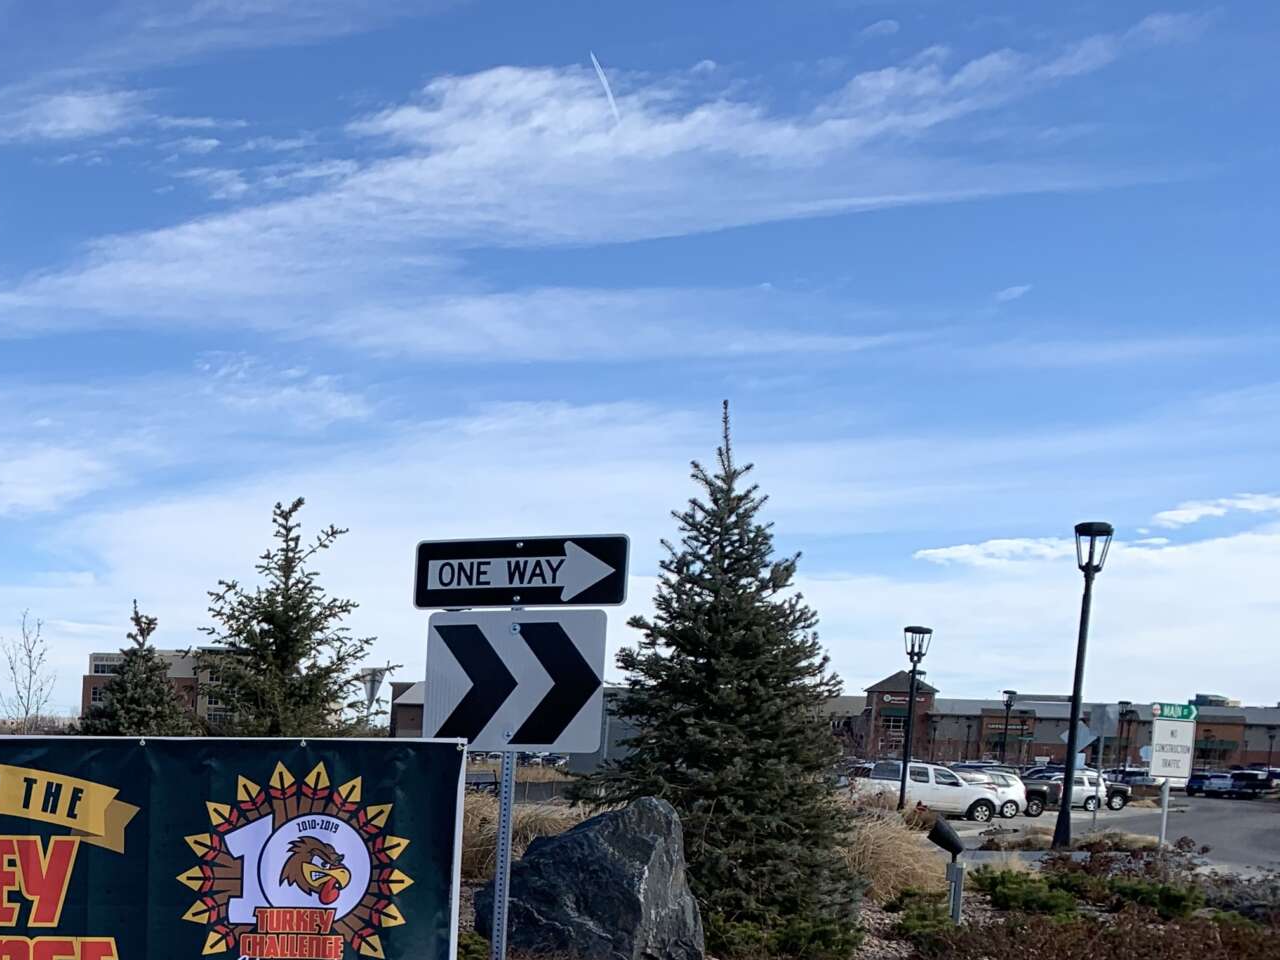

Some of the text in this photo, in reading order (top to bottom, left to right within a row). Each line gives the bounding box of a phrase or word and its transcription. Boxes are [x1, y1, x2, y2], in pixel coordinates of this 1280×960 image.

[438, 559, 566, 587] ONE WAY
[1163, 704, 1183, 717] MAIN
[1155, 743, 1191, 754] CONSTRUCTION
[1161, 758, 1182, 768] TRAFFIC
[22, 776, 84, 820] THE
[255, 907, 335, 933] TURKEY
[239, 934, 344, 960] CHALLENGE
